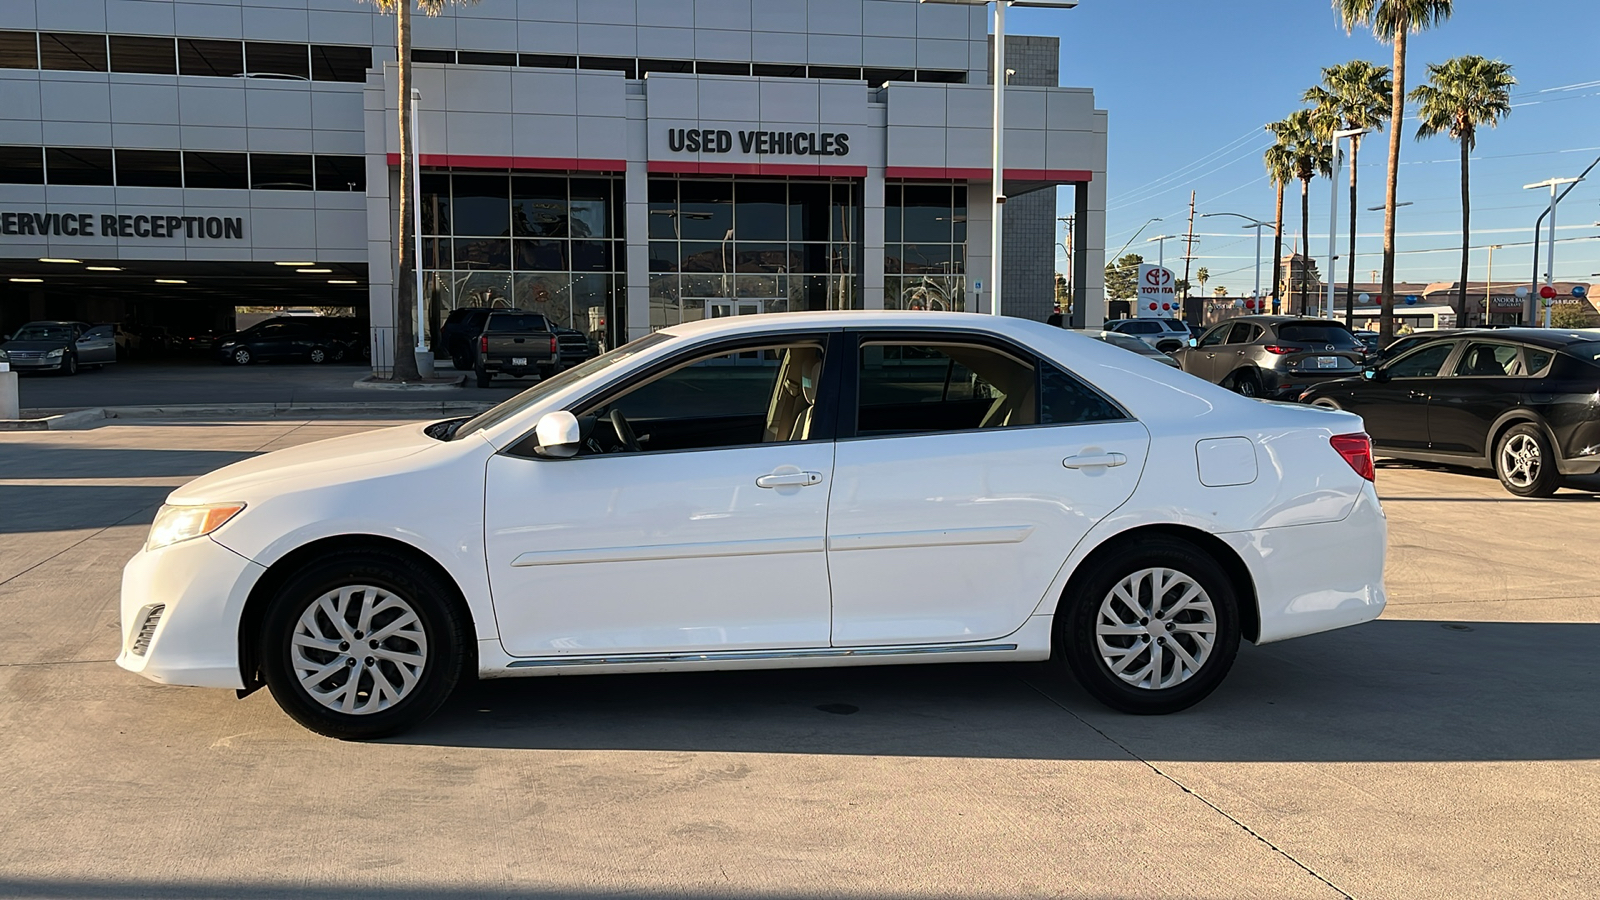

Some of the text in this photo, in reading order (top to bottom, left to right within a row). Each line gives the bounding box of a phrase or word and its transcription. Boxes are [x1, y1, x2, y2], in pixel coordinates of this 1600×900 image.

[668, 128, 850, 156] USED VEHICLES
[0, 212, 243, 239] ERVICE RECEPTION
